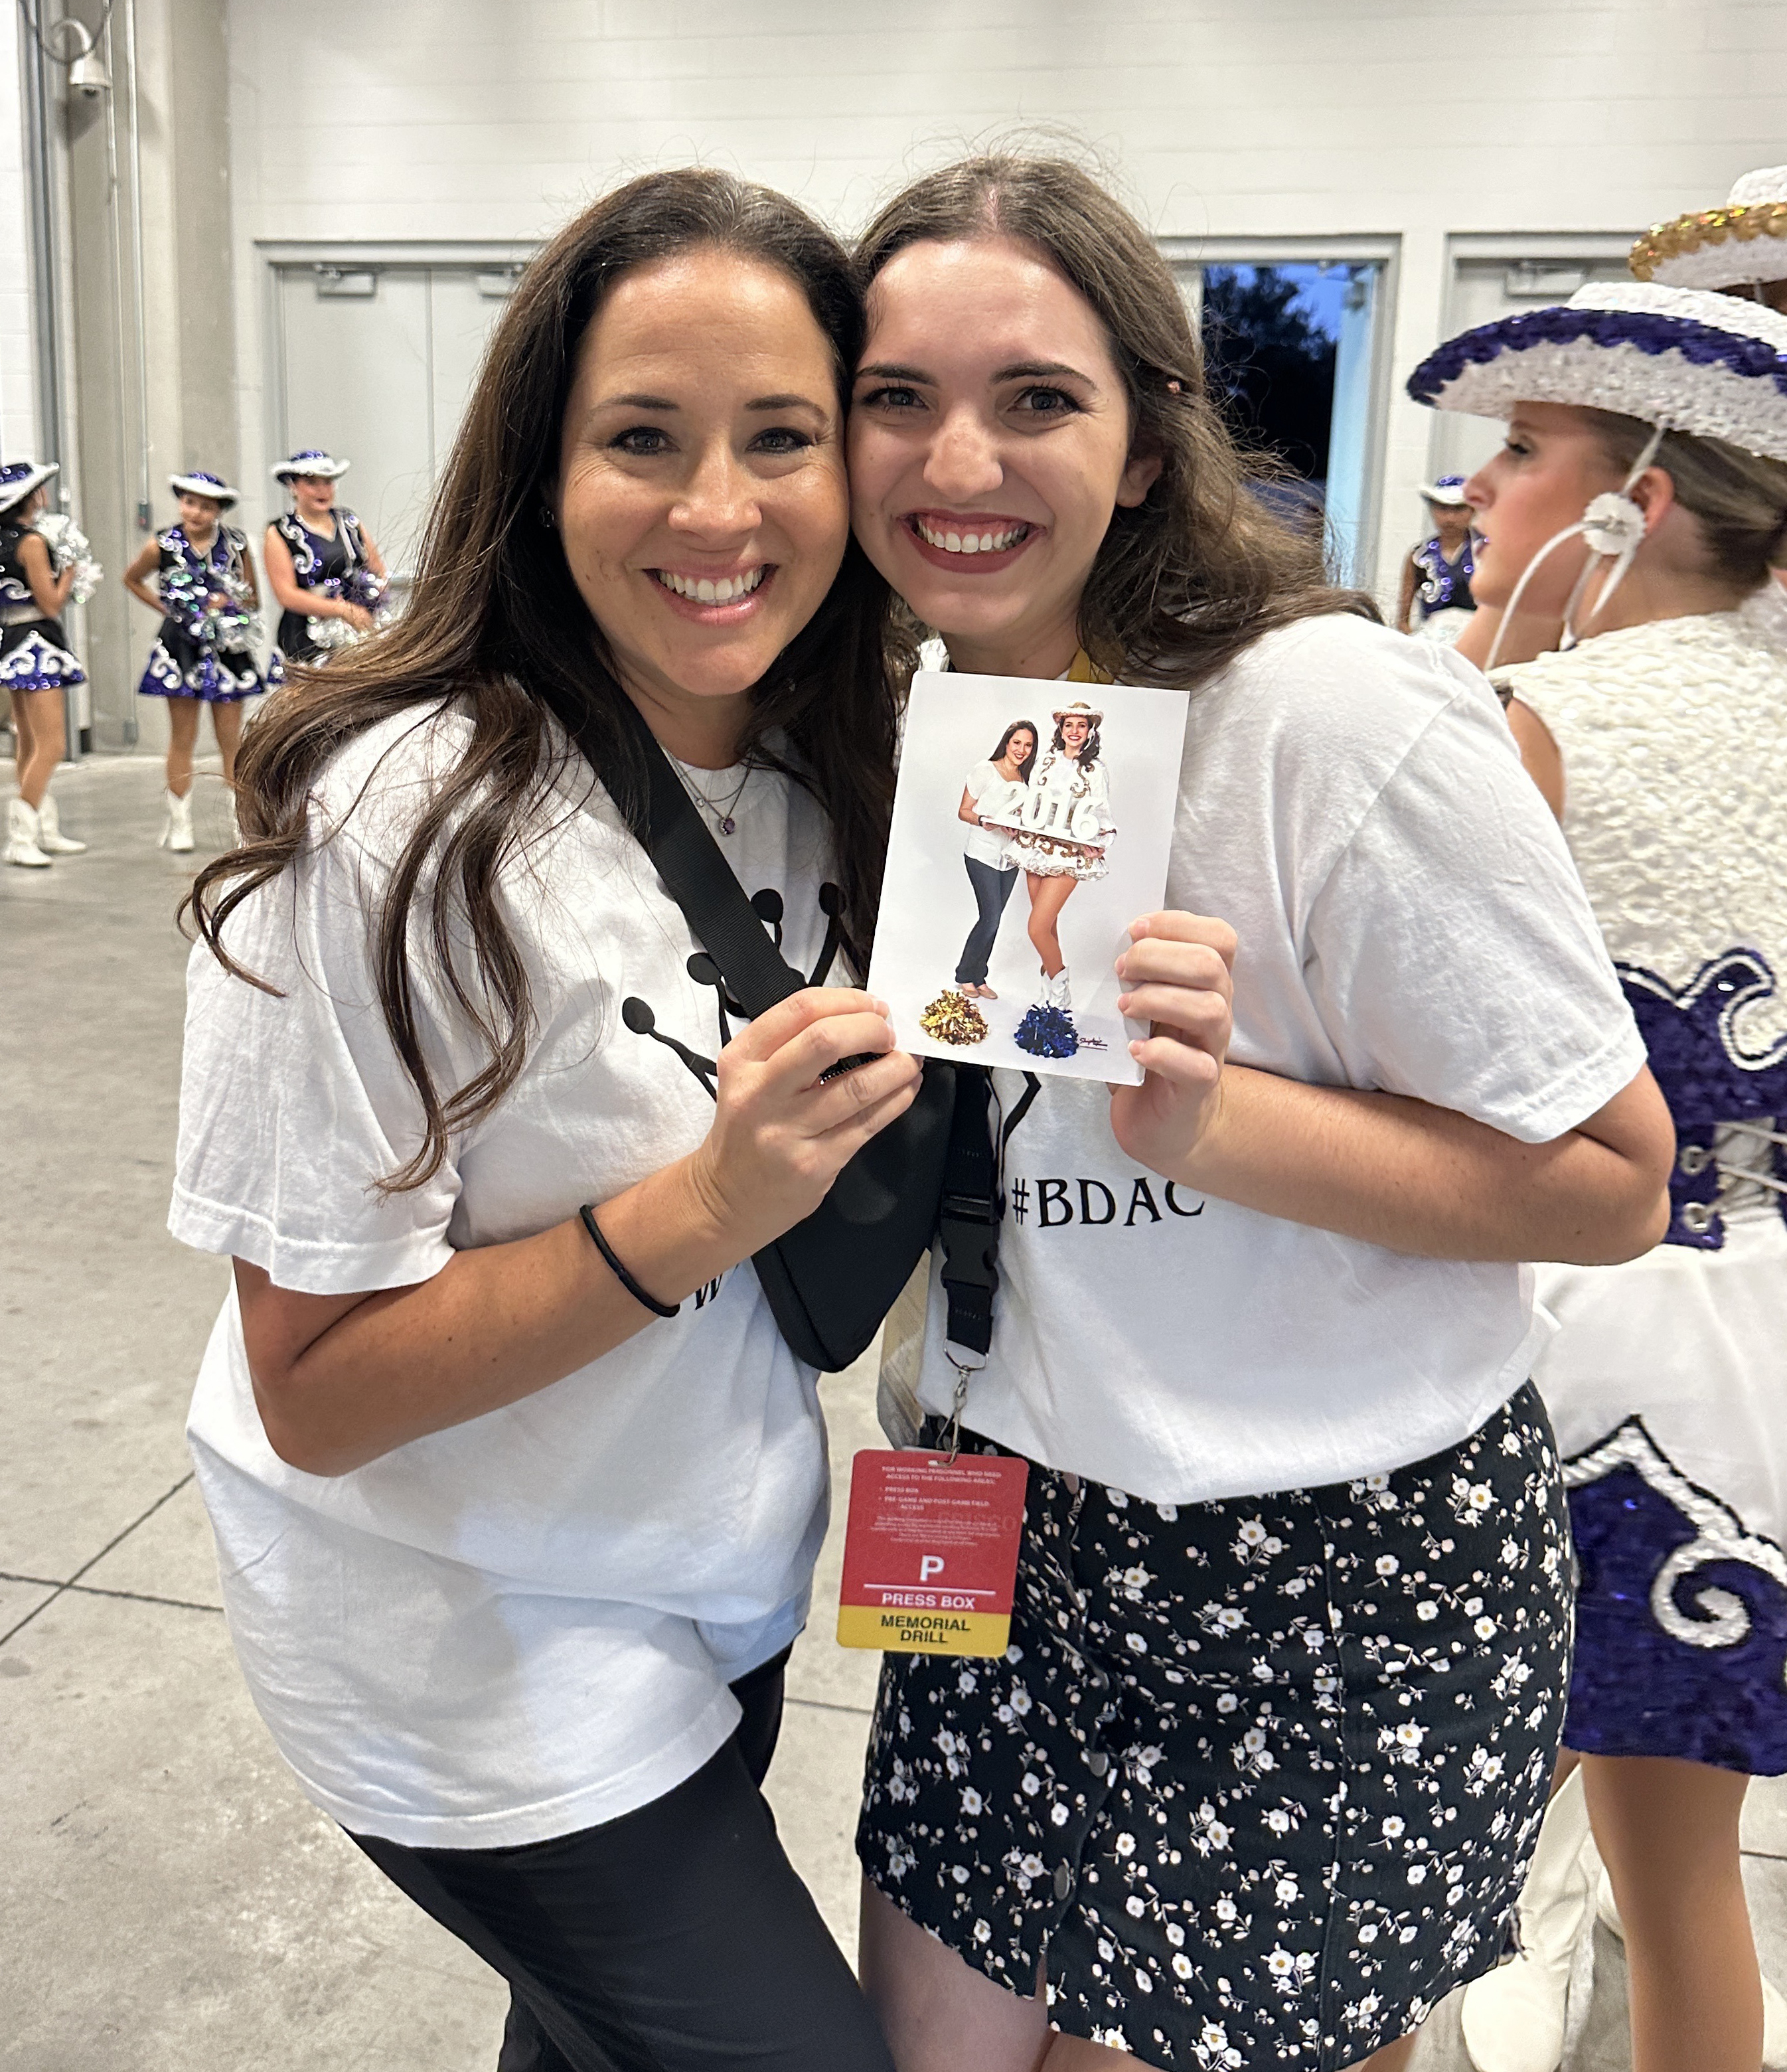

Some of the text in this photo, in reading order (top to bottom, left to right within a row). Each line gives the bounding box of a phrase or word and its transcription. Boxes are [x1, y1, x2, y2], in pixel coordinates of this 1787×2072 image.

[994, 781, 1103, 840] 2016
[919, 1555, 945, 1581] P
[882, 1591, 976, 1611] PRESS BOX
[881, 1615, 971, 1631] MEMORIAL
[900, 1629, 949, 1643] DRILL
